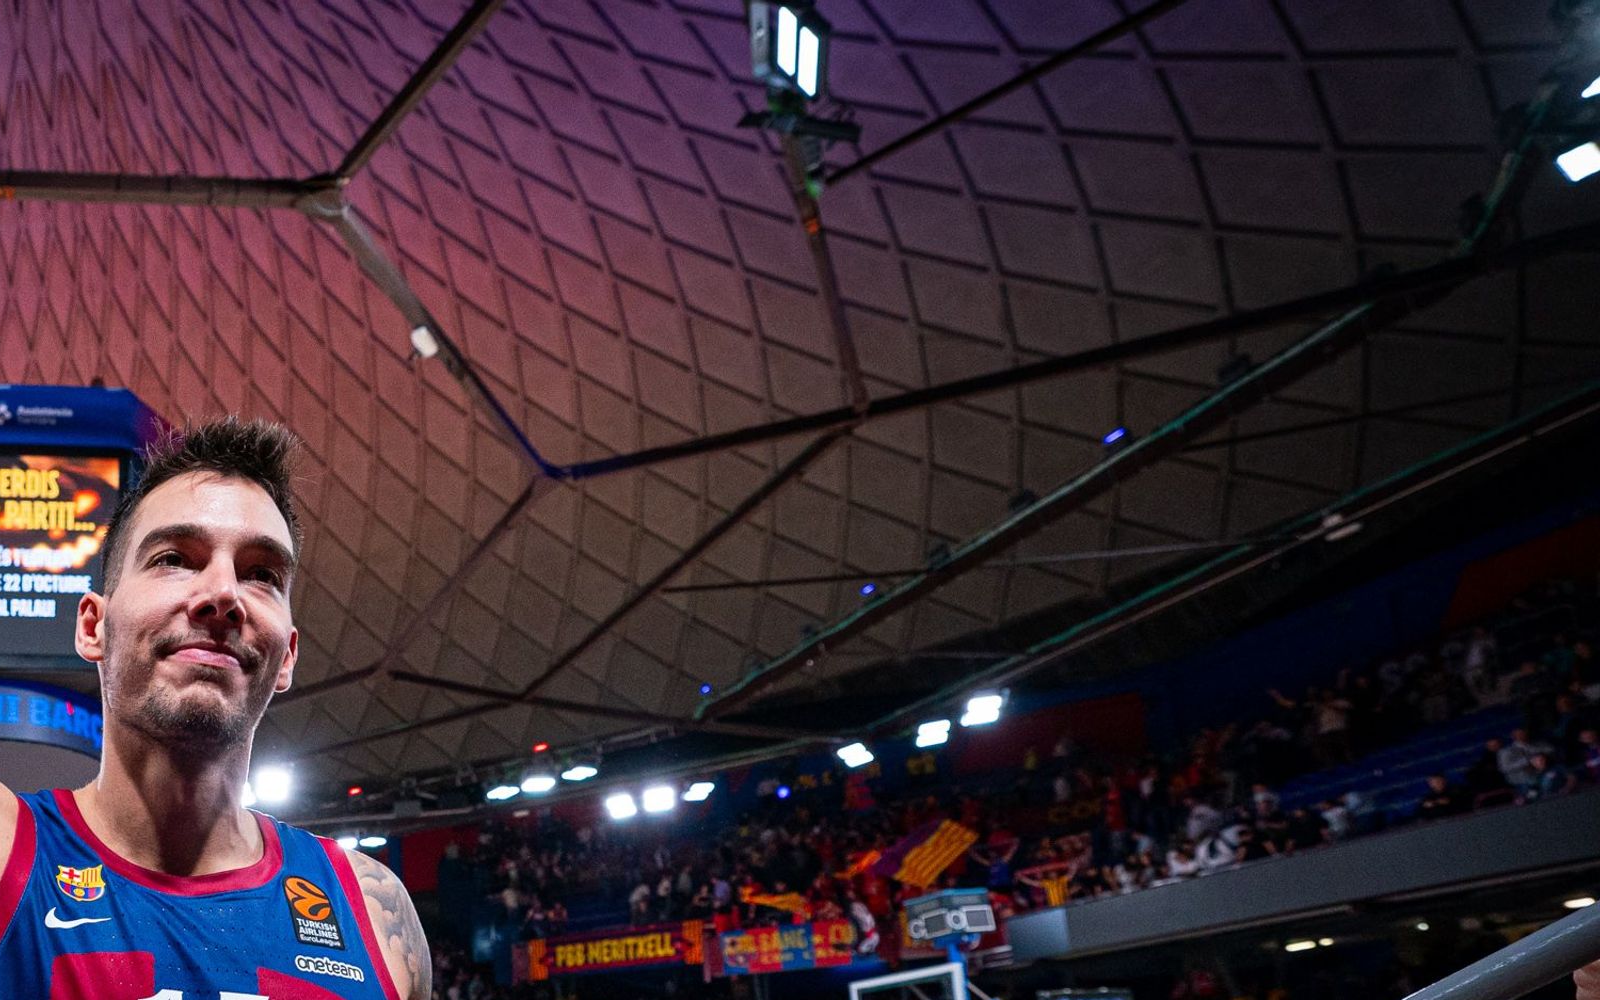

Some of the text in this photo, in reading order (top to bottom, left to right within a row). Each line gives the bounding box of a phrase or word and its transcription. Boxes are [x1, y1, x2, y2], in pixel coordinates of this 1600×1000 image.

[3, 573, 21, 592] 22
[29, 696, 103, 750] BARÇ
[296, 918, 337, 932] TURKISH
[299, 926, 340, 940] AIRLINES
[296, 956, 364, 981] oneteam
